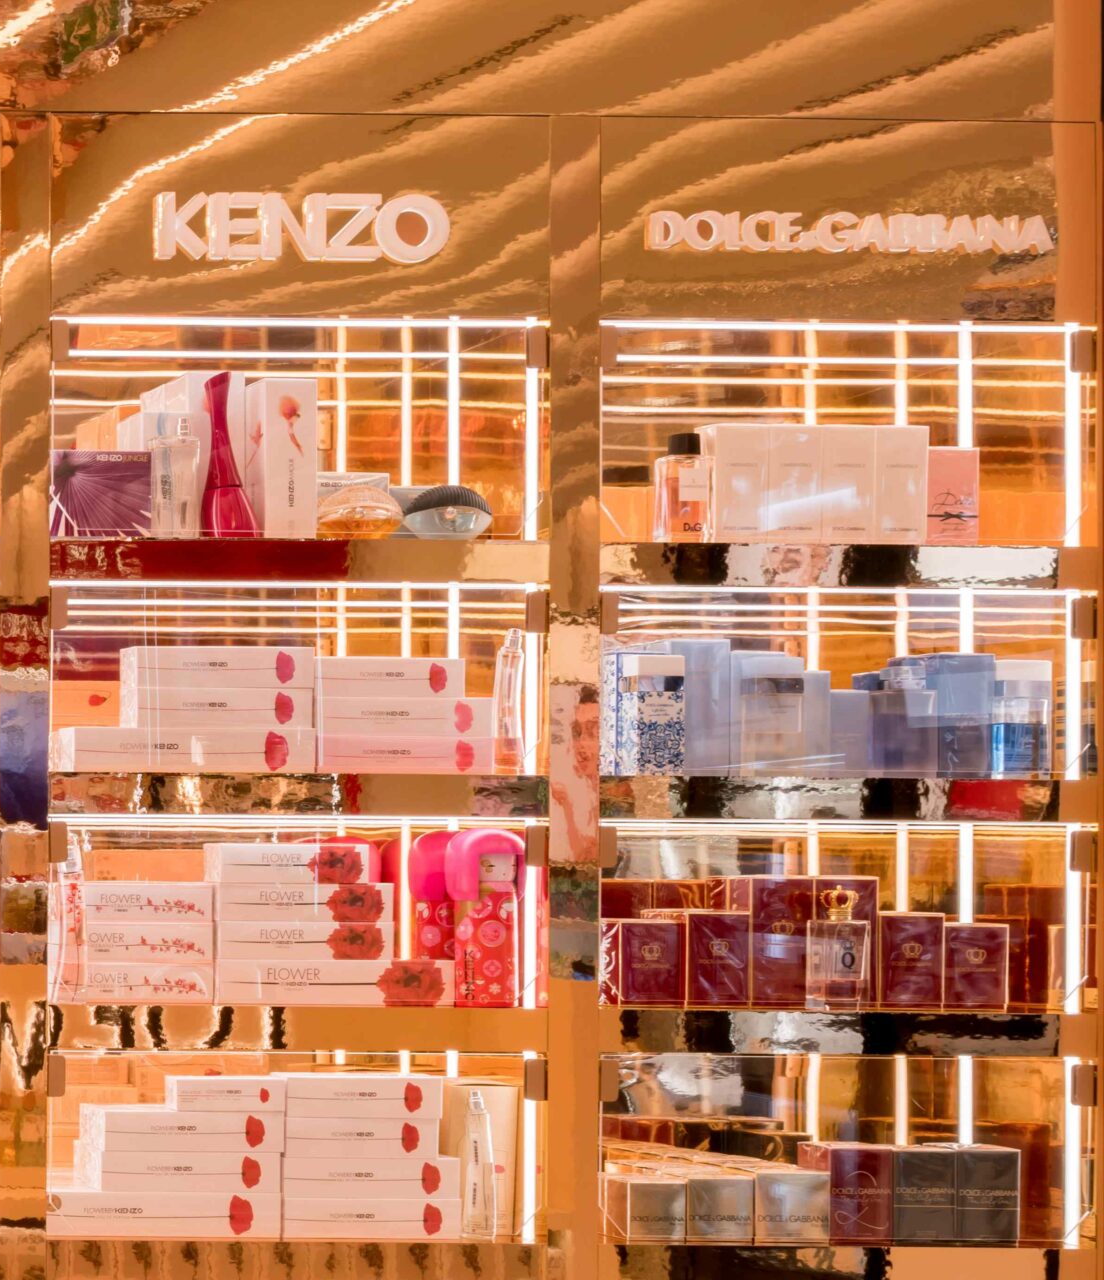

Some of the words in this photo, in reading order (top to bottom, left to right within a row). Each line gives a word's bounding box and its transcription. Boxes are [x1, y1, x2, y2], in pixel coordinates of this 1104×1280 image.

[153, 192, 450, 263] KENZO
[262, 853, 302, 862] FLOWER
[100, 894, 141, 904] FLOWER
[260, 891, 304, 901] FLOWER
[260, 929, 304, 939] FLOWER
[841, 951, 855, 969] Q
[267, 968, 320, 980] FLOWER
[464, 949, 475, 1001] KENZO
